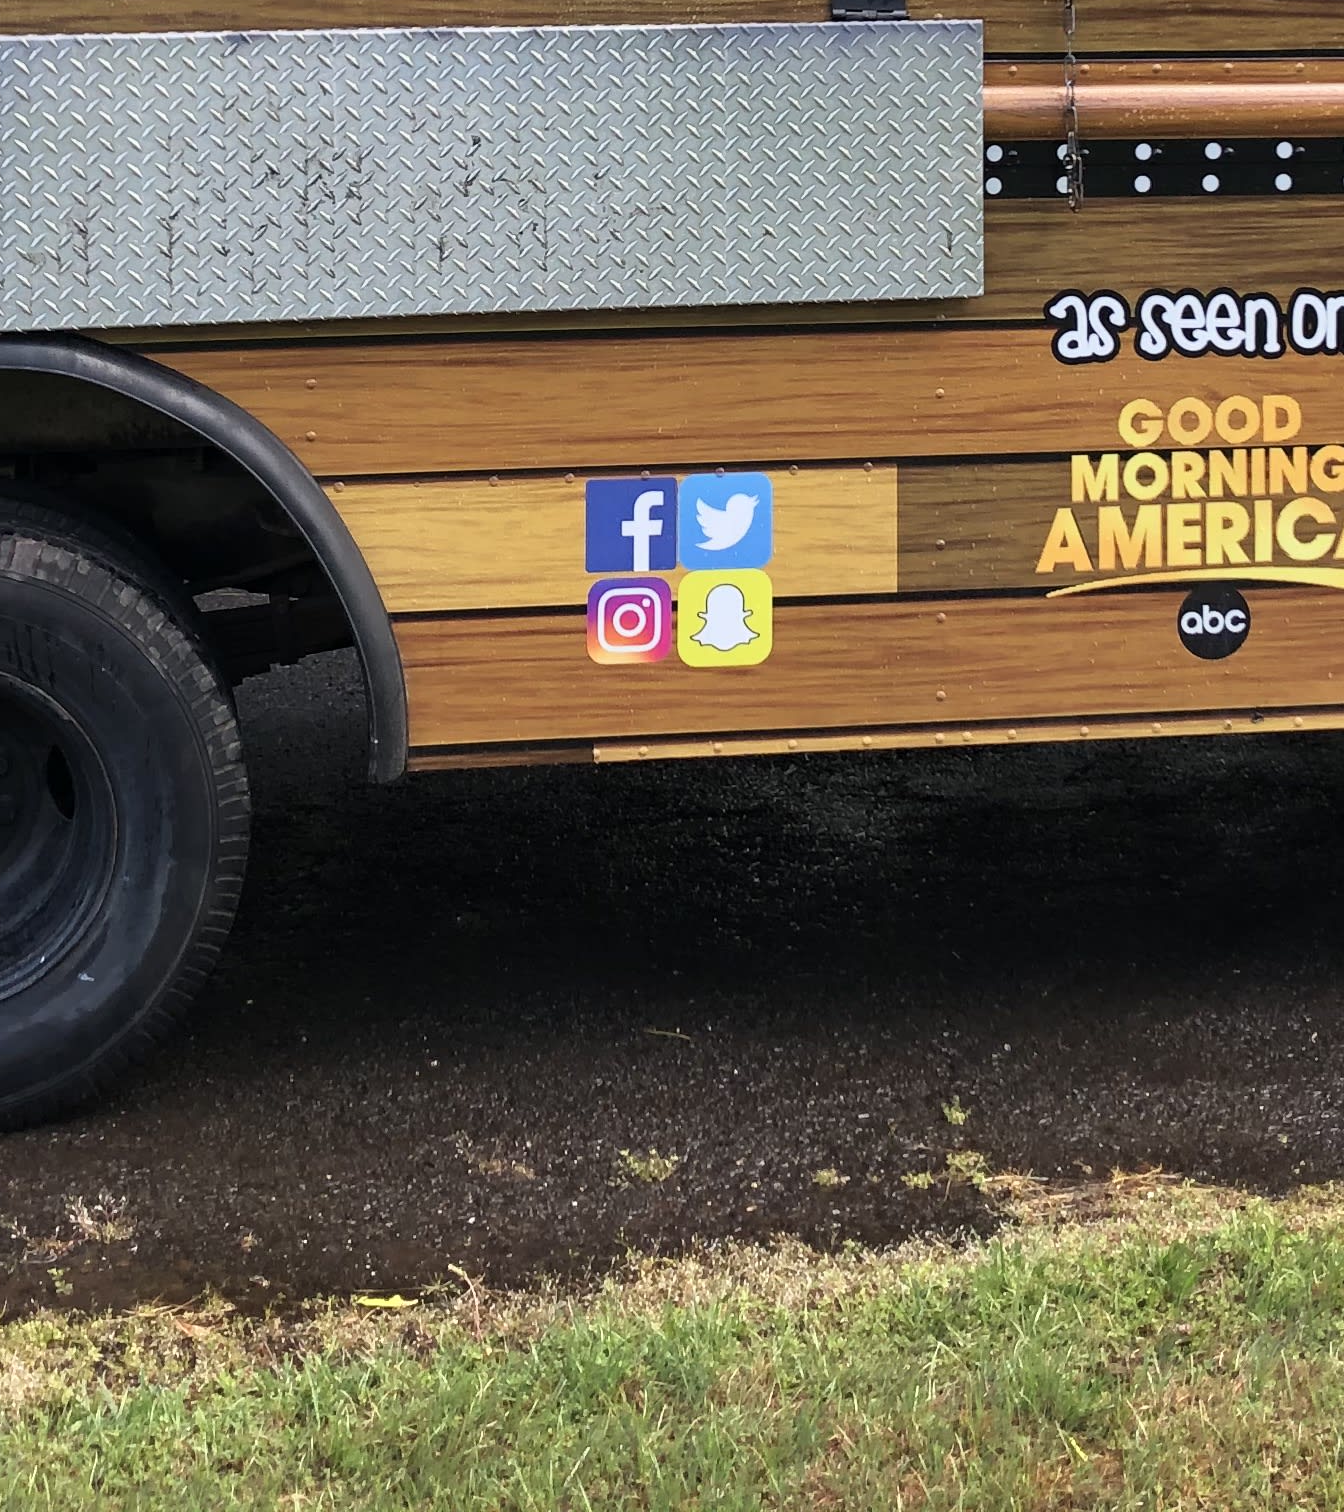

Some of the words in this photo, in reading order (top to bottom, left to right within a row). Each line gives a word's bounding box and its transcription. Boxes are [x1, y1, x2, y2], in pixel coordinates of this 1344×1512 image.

[1049, 293, 1127, 359] as
[1139, 293, 1282, 356] seen
[1118, 393, 1303, 448] GOOD
[1180, 604, 1247, 636] abc
